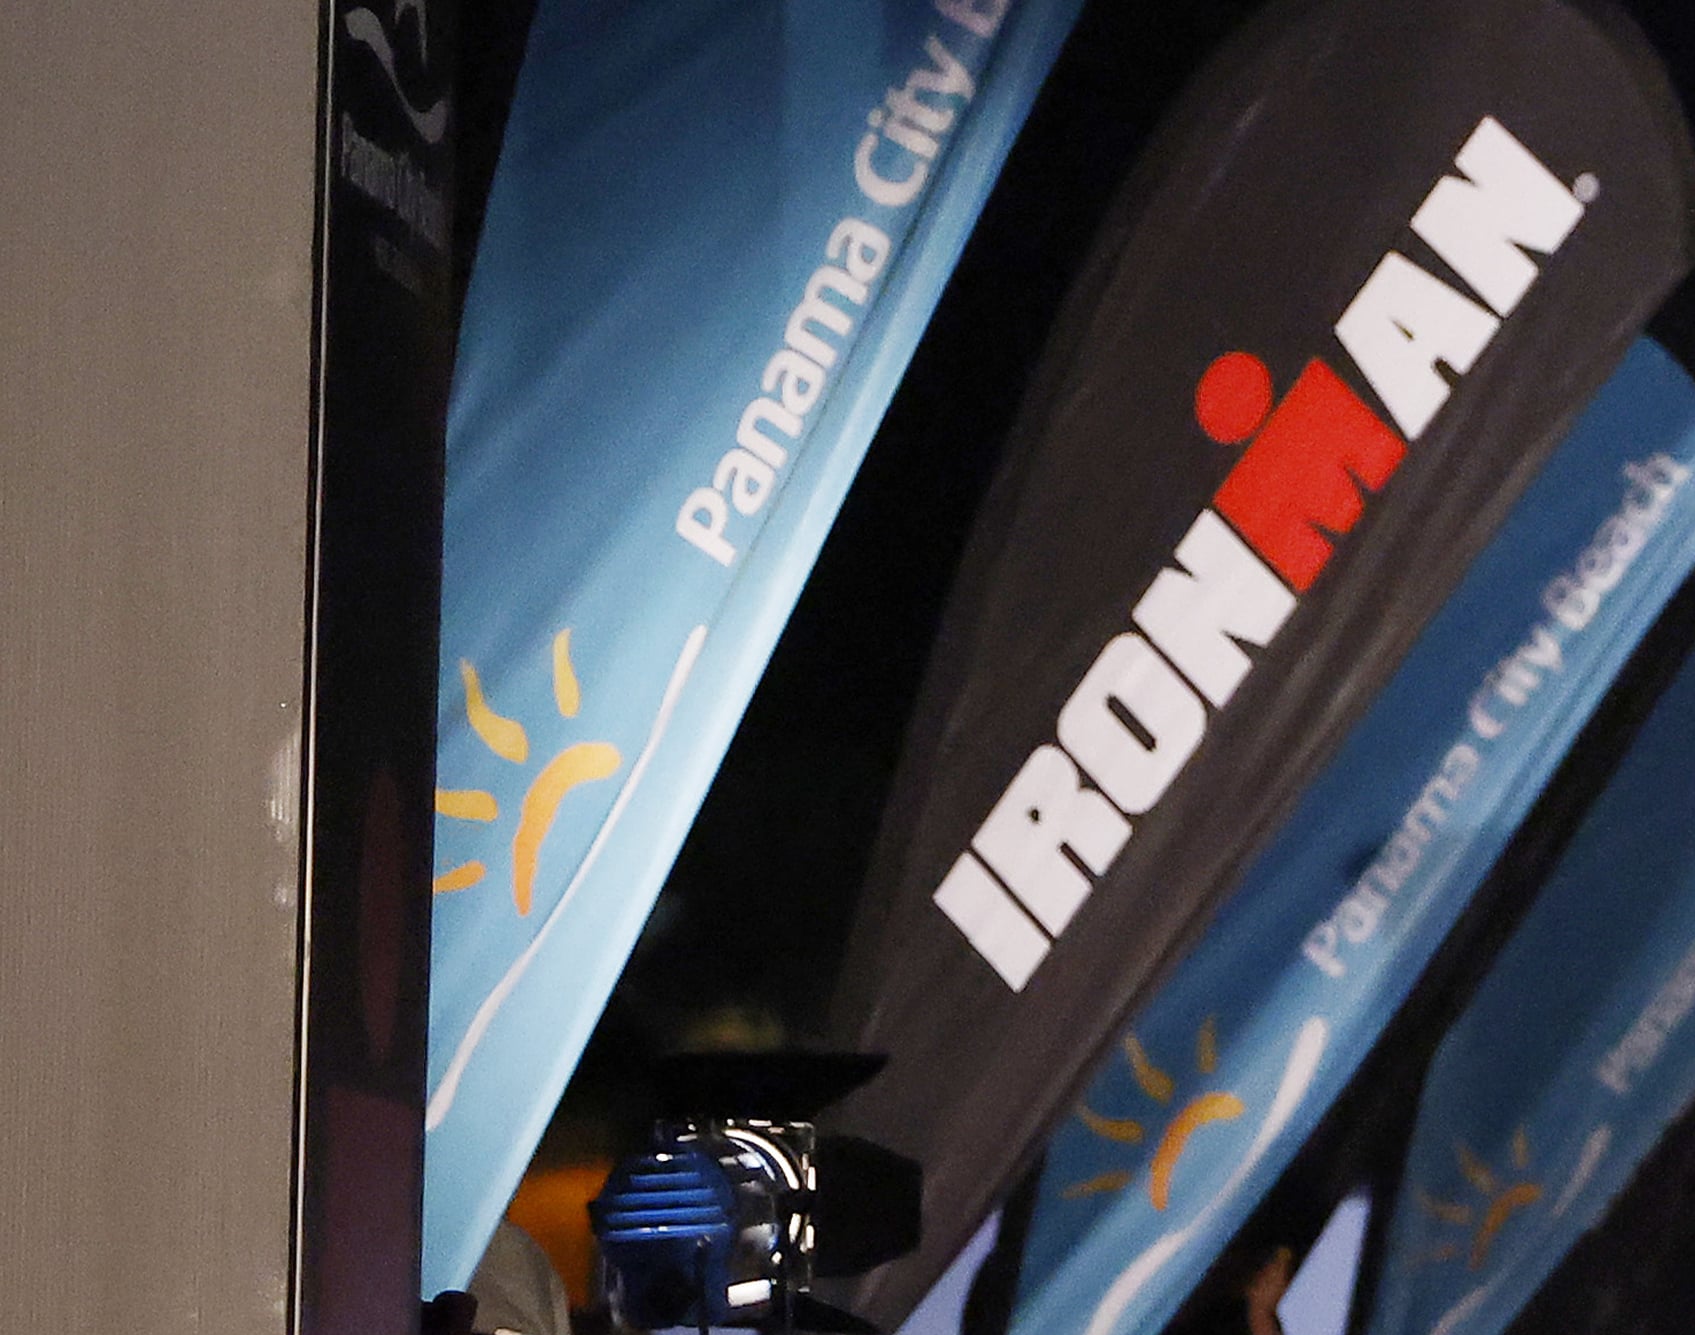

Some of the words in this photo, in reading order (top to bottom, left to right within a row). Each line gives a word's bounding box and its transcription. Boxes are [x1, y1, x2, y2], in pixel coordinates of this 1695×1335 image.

[675, 216, 893, 567] Panama
[854, 36, 977, 207] City
[932, 113, 1586, 994] IRONMAN
[1467, 622, 1564, 740] City
[1539, 451, 1693, 631] Beach
